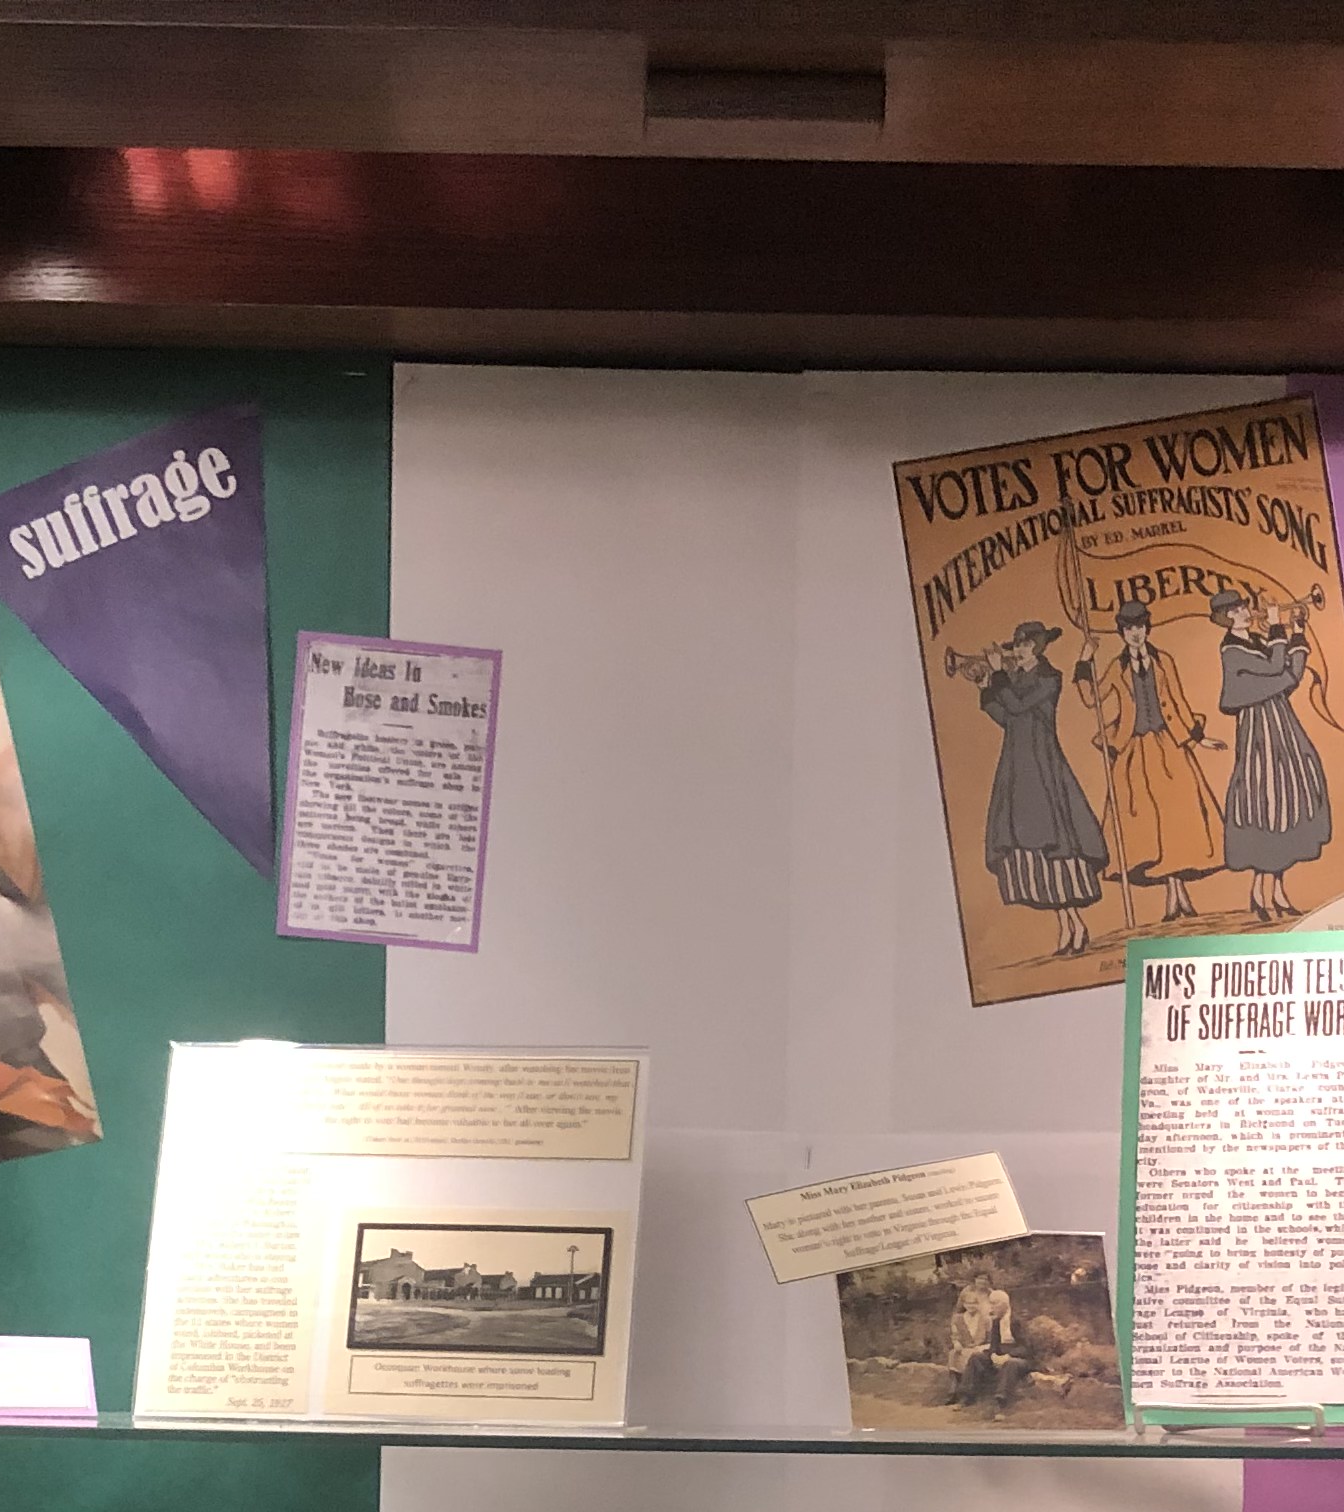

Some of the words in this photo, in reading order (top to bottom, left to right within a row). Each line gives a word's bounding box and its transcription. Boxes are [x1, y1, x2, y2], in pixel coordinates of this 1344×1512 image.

[906, 458, 1039, 524] VOTES
[1051, 442, 1139, 499] FOR
[1143, 414, 1309, 483] WOMEN
[8, 446, 238, 580] suffrage
[1081, 535, 1099, 549] BY
[922, 498, 1106, 641] INTERNATIONAL
[1113, 485, 1253, 526] SUFFRAGISTS'
[1256, 493, 1328, 574] SONG
[1085, 565, 1267, 612] LIBERTY
[311, 652, 343, 675] New
[355, 656, 396, 680] Ideas
[405, 660, 422, 682] In
[390, 694, 419, 713] and
[428, 693, 487, 719] Smokes
[1145, 963, 1196, 1000] MISS
[1211, 959, 1293, 998] PIDGEON
[1167, 1004, 1191, 1041] OF
[1198, 1000, 1295, 1041] SUFFRAGE
[1197, 1075, 1208, 1083] of
[1139, 1134, 1157, 1143] day
[1149, 1168, 1186, 1176] Others
[1225, 1167, 1255, 1176] spoke
[1254, 1225, 1271, 1233] the
[1282, 1284, 1294, 1292] of
[1300, 1284, 1317, 1292] the
[1217, 1308, 1229, 1316] of
[1305, 1308, 1328, 1316] who
